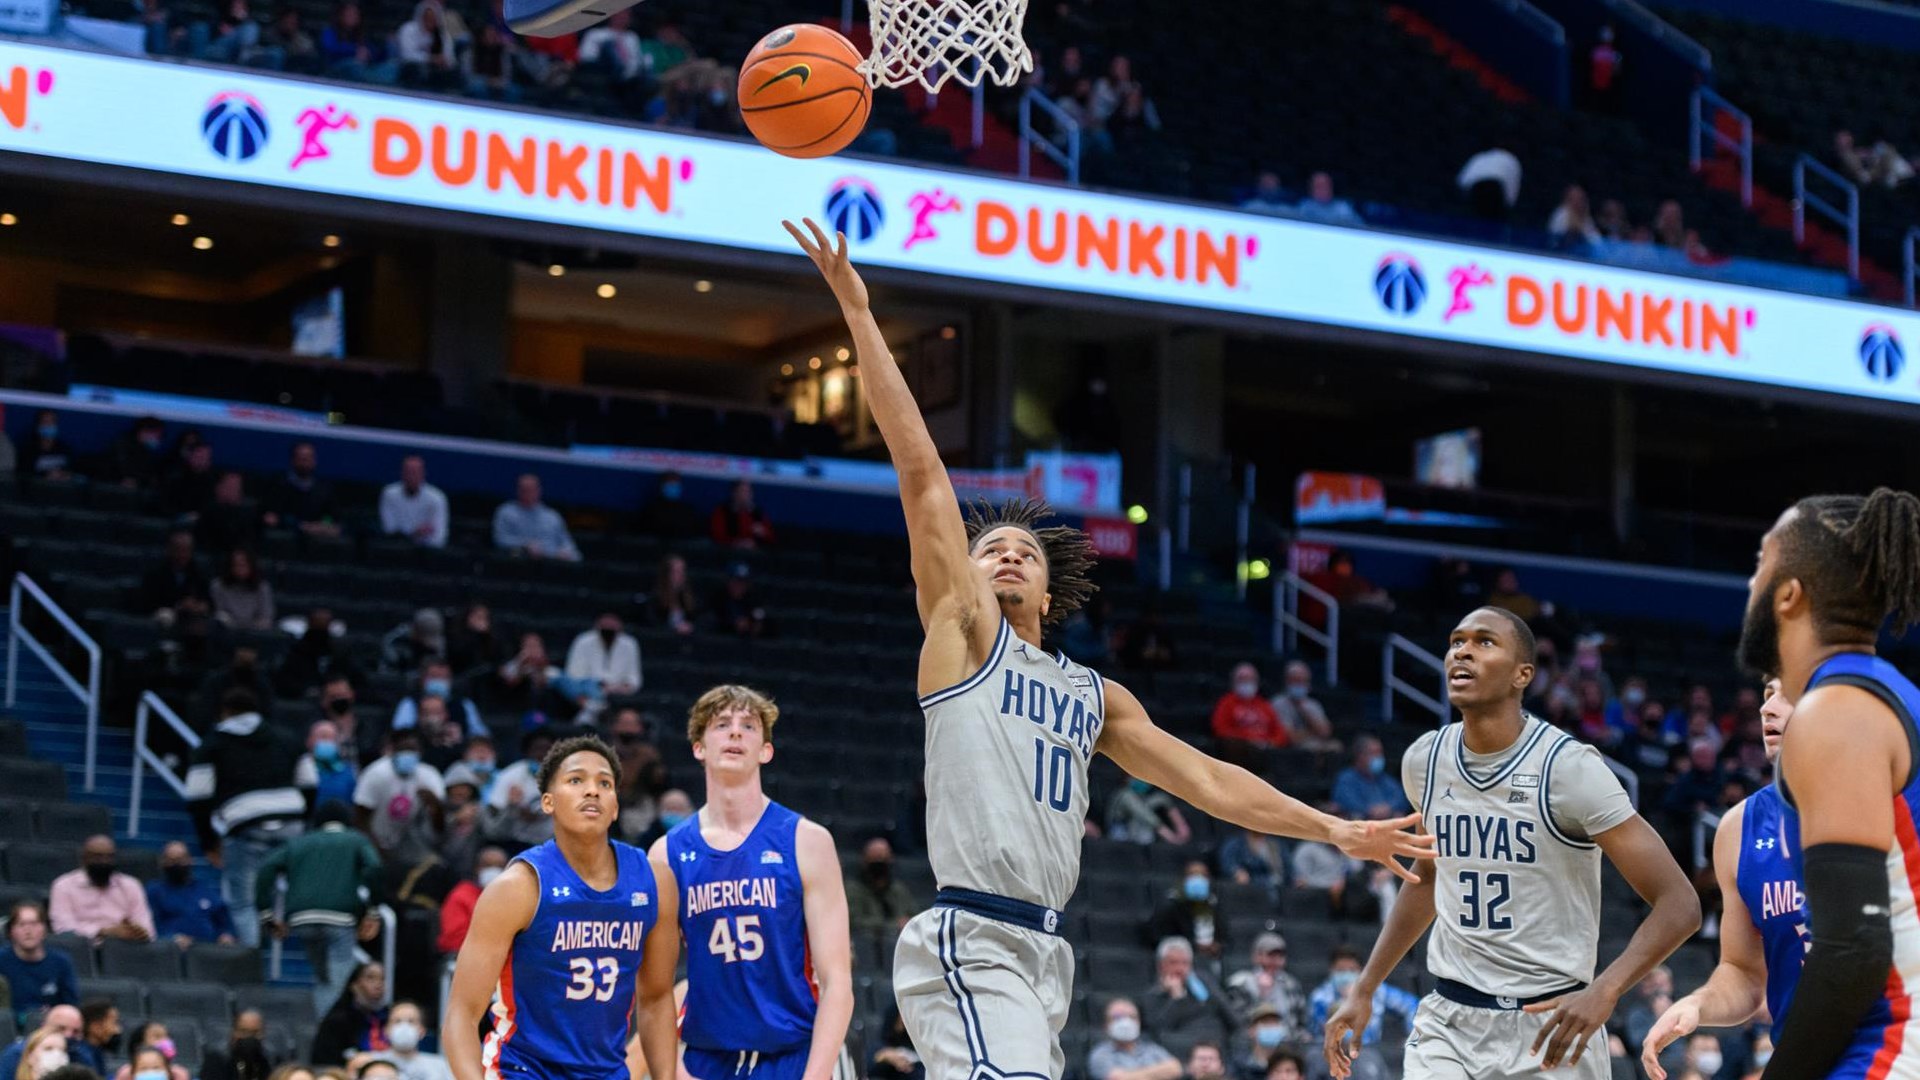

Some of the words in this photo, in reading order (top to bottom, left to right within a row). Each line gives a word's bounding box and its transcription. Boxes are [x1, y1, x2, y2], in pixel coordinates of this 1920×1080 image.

[372, 117, 692, 213] DUNKIN'
[976, 201, 1256, 287] DUNKIN'
[1507, 276, 1754, 356] DUNKIN'
[1000, 668, 1099, 761] HOYAS
[1034, 736, 1072, 813] 10
[1435, 814, 1536, 864] HOYAS
[687, 877, 776, 918] AMERICAN
[1459, 870, 1512, 930] 32
[551, 920, 643, 953] AMERICAN
[708, 915, 765, 963] 45
[566, 956, 619, 1002] 33
